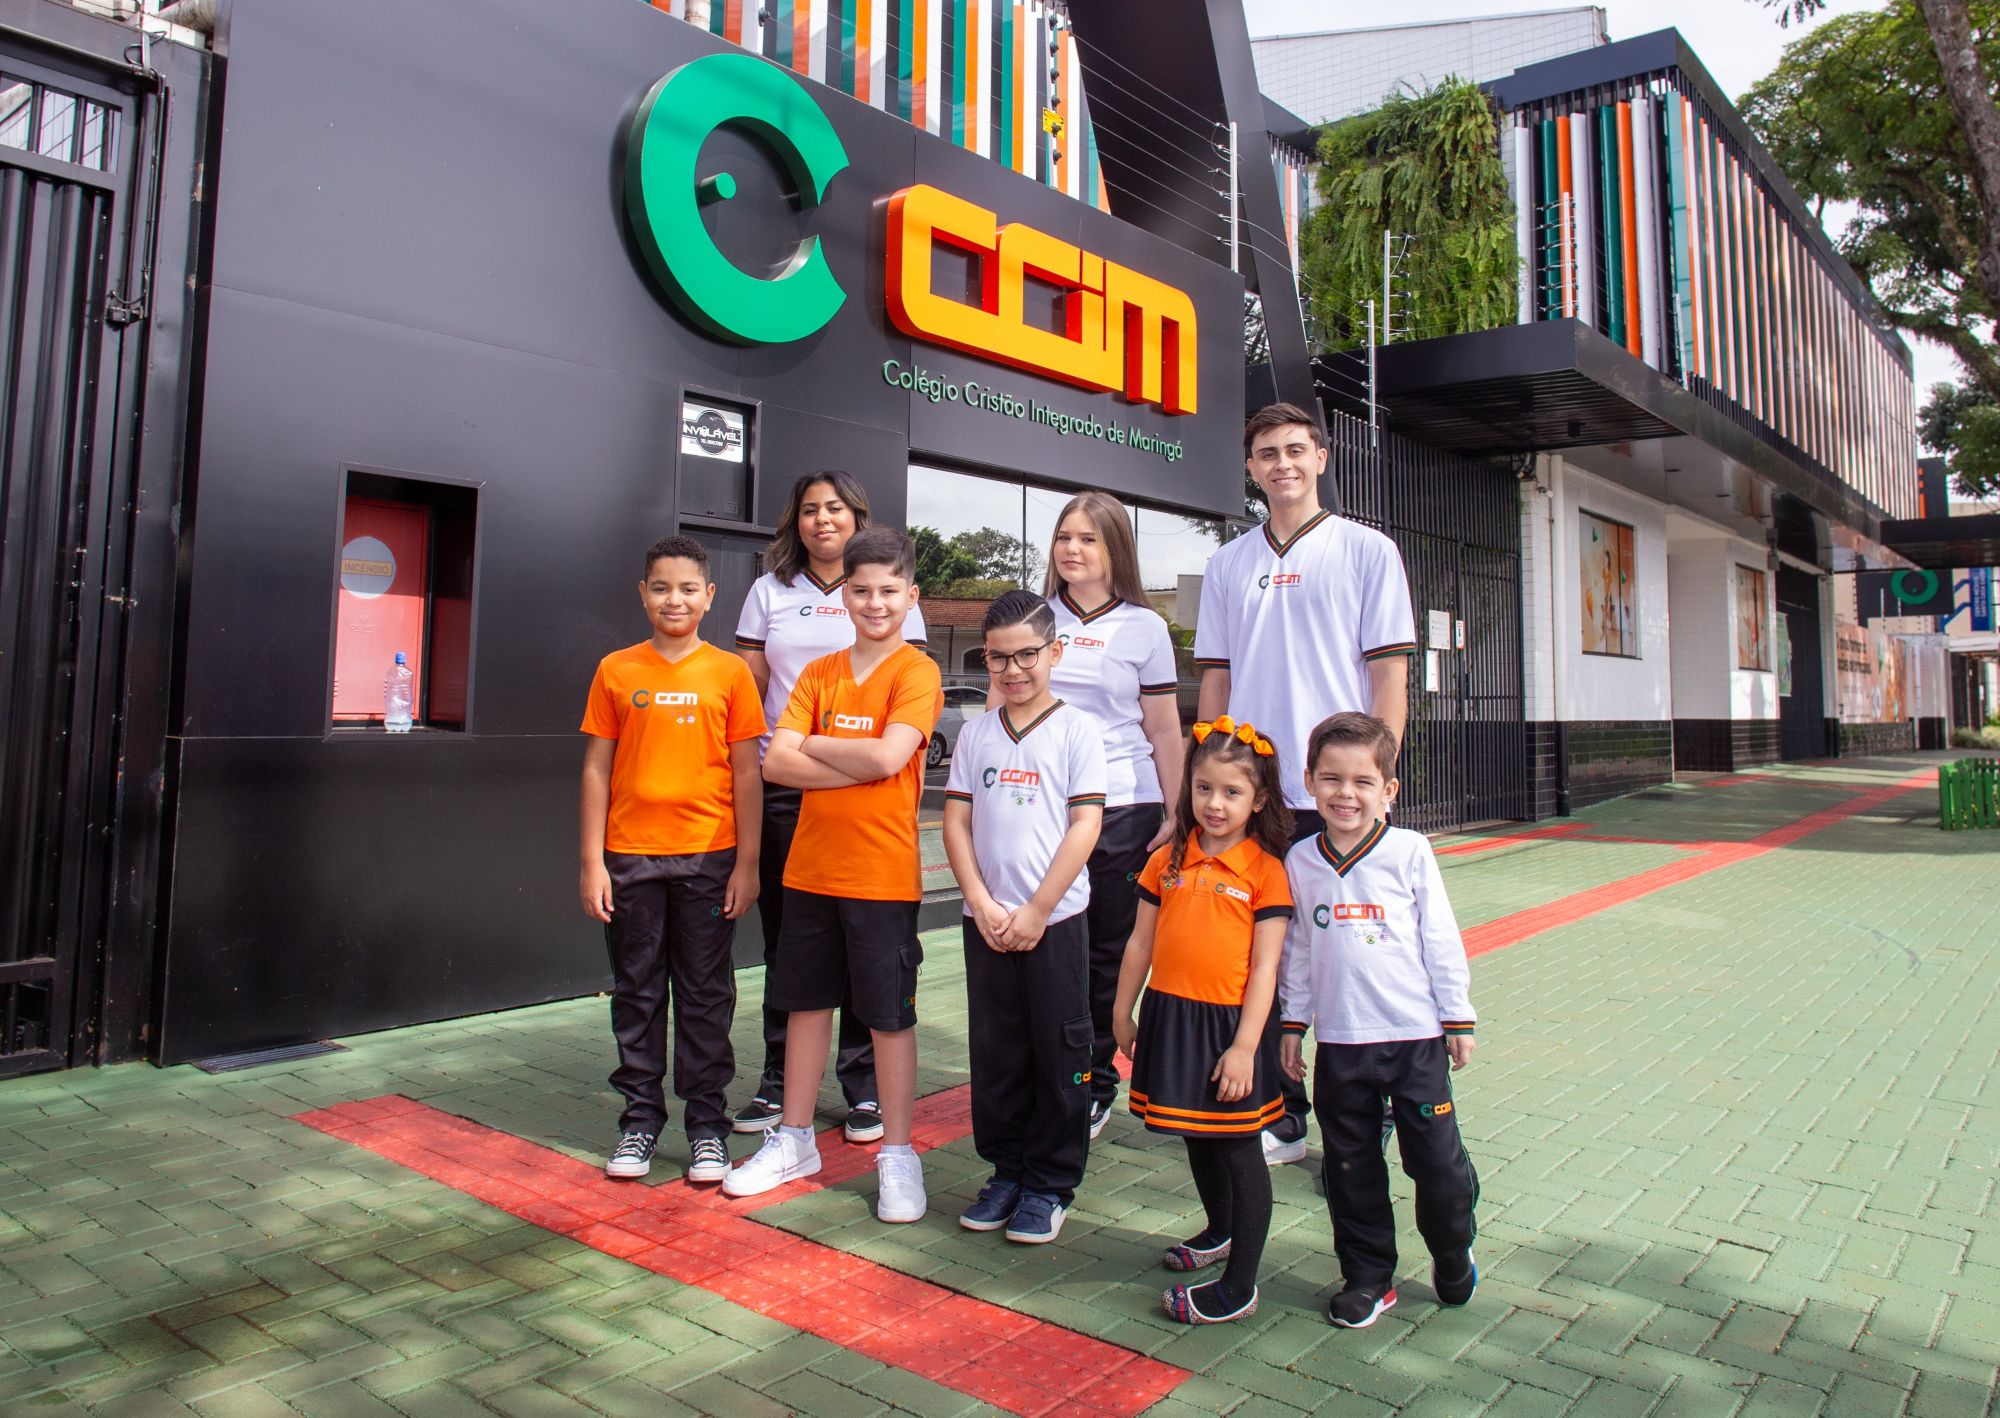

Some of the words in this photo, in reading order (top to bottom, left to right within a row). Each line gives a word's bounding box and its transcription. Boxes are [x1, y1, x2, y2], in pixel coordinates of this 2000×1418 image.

[882, 359, 959, 403] Colégio
[963, 381, 1025, 418] Cristão
[1029, 399, 1103, 438] Integrado
[1106, 420, 1125, 444] de
[1127, 426, 1183, 462] Maringá
